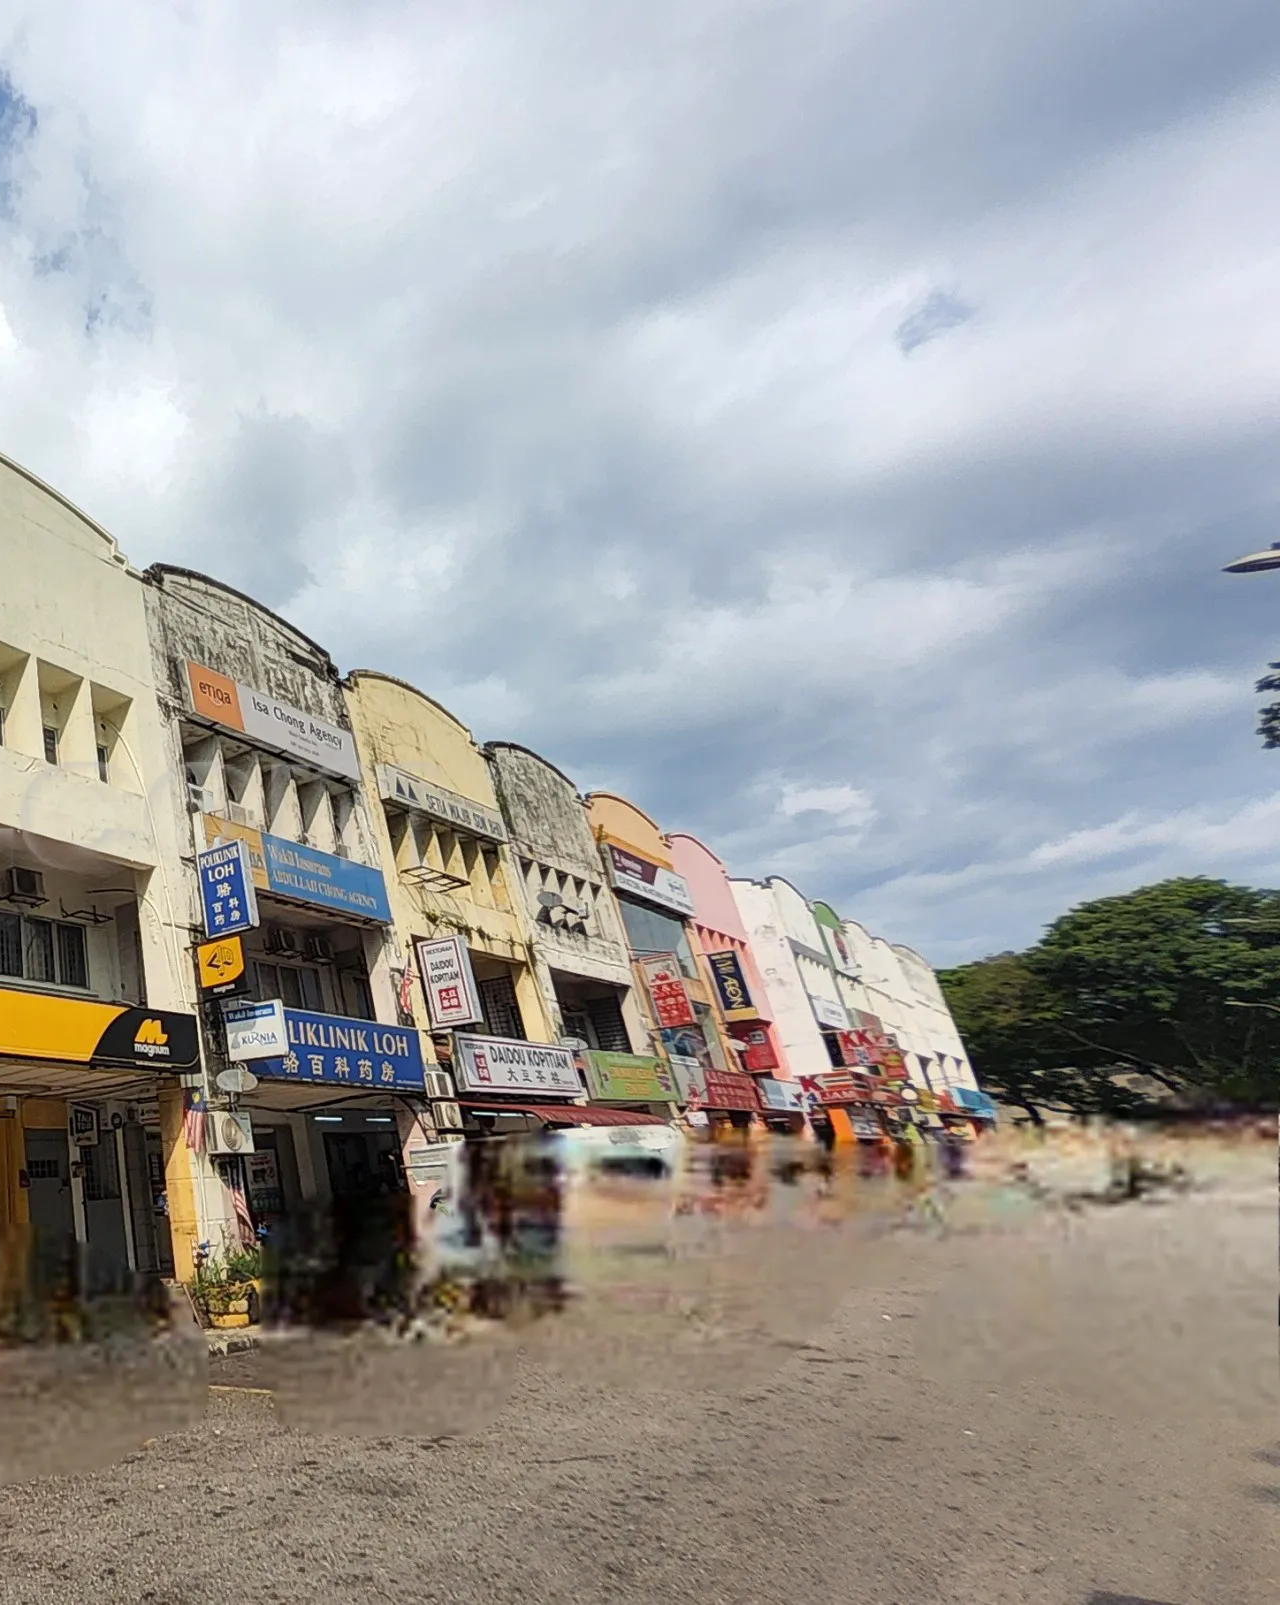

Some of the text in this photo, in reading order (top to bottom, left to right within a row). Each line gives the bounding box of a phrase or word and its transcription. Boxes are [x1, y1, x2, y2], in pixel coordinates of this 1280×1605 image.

[252, 697, 269, 716] Isa
[273, 706, 306, 735] Chong
[309, 722, 342, 750] Agency
[207, 862, 235, 883] LOH
[272, 869, 318, 893] ABDULLAH
[430, 958, 454, 972] DAIDOU
[430, 971, 460, 984] KOPITIAM
[241, 1031, 278, 1046] KURNIA
[288, 1019, 410, 1058] LIKLINIK LOH
[133, 1043, 171, 1058] magnum
[488, 1045, 571, 1070] DAIDOU KOPITIAM
